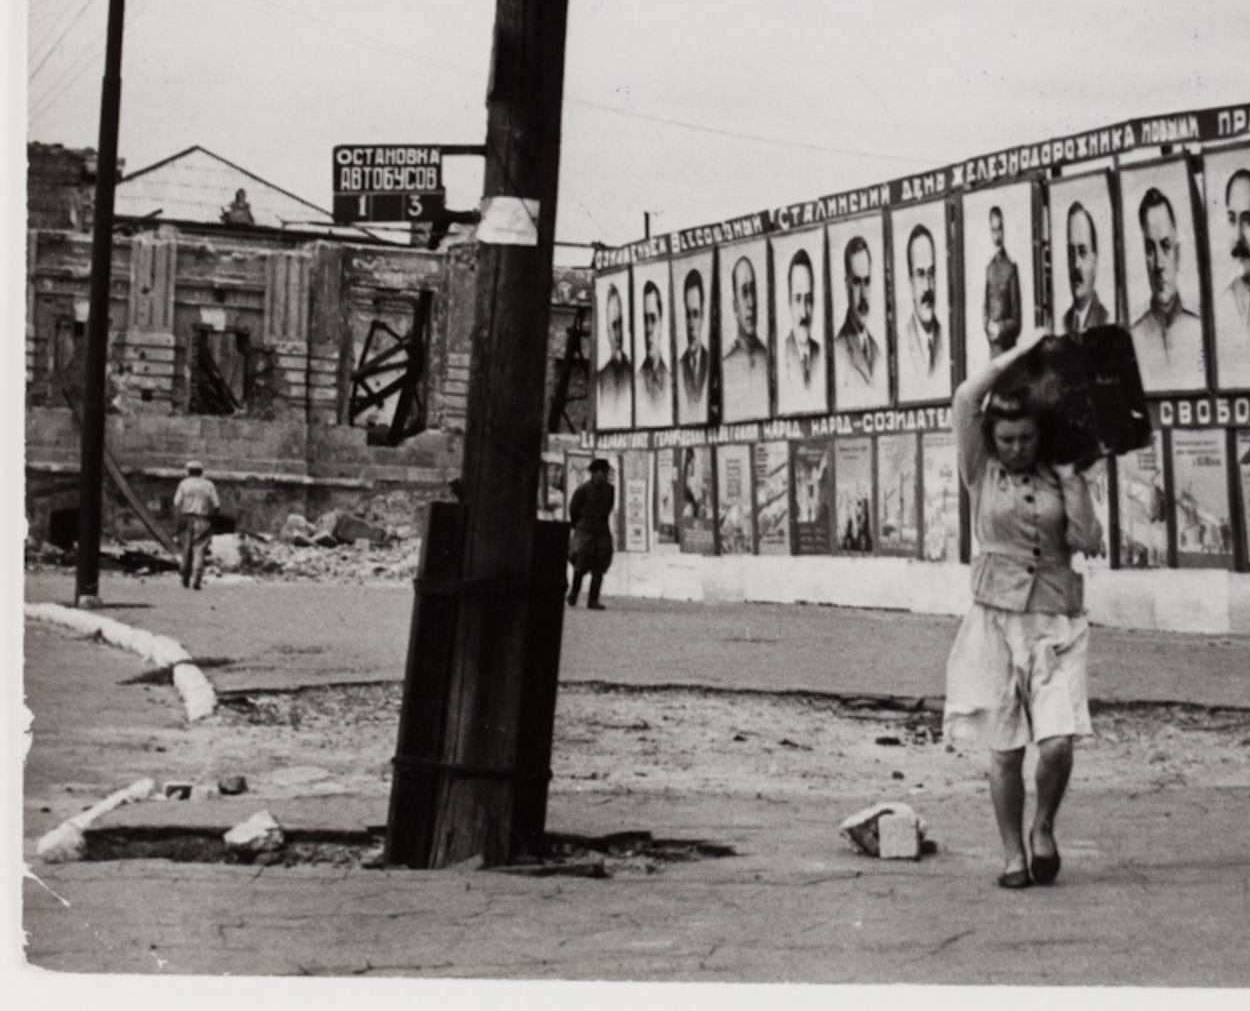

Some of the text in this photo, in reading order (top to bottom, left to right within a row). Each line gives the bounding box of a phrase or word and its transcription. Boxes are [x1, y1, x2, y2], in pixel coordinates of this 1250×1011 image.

[336, 148, 440, 166] ОСТАНОВКА
[951, 124, 1136, 187] ЖЕЛЕЗНОДОРОЖНИКА
[340, 167, 438, 191] АВТОБУСОВ
[357, 195, 424, 217] 1 3
